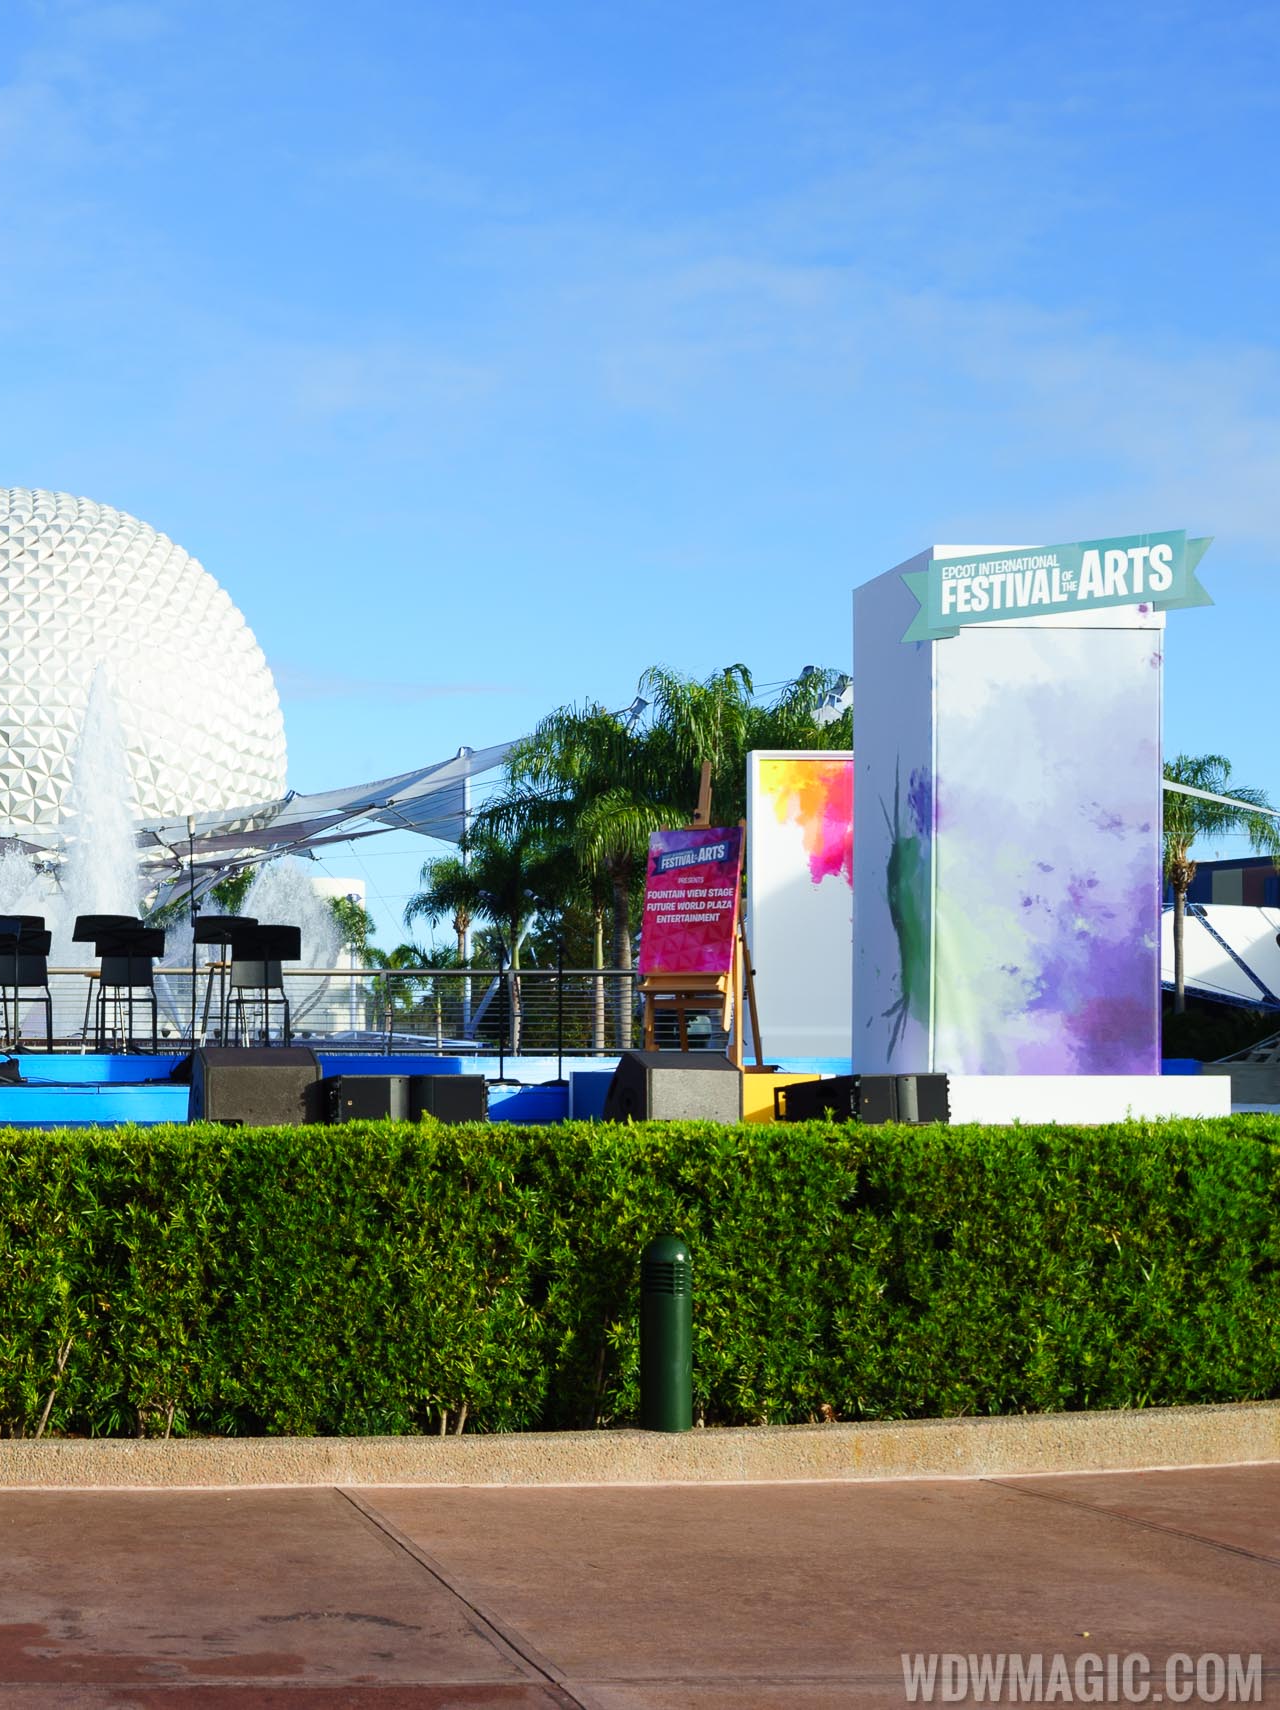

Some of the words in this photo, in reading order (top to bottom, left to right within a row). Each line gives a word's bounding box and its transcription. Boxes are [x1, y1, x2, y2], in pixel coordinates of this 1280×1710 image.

[942, 564, 976, 581] EPCOT
[978, 554, 1060, 575] INTERNATIONAL
[1077, 544, 1173, 600] ARTS
[1061, 570, 1074, 582] OF
[942, 568, 1068, 615] FESTIVAL
[1061, 581, 1078, 592] THE
[661, 854, 696, 870] FESTIVAL
[697, 844, 725, 862] ARTS
[647, 890, 686, 900] FOUNTAIN
[687, 888, 707, 898] VIEW
[708, 888, 734, 897] STAGE
[646, 902, 676, 912] FUTURE
[677, 901, 706, 911] WORLD
[706, 900, 732, 910] PLAZA
[656, 913, 720, 924] ENTERTAINMENT
